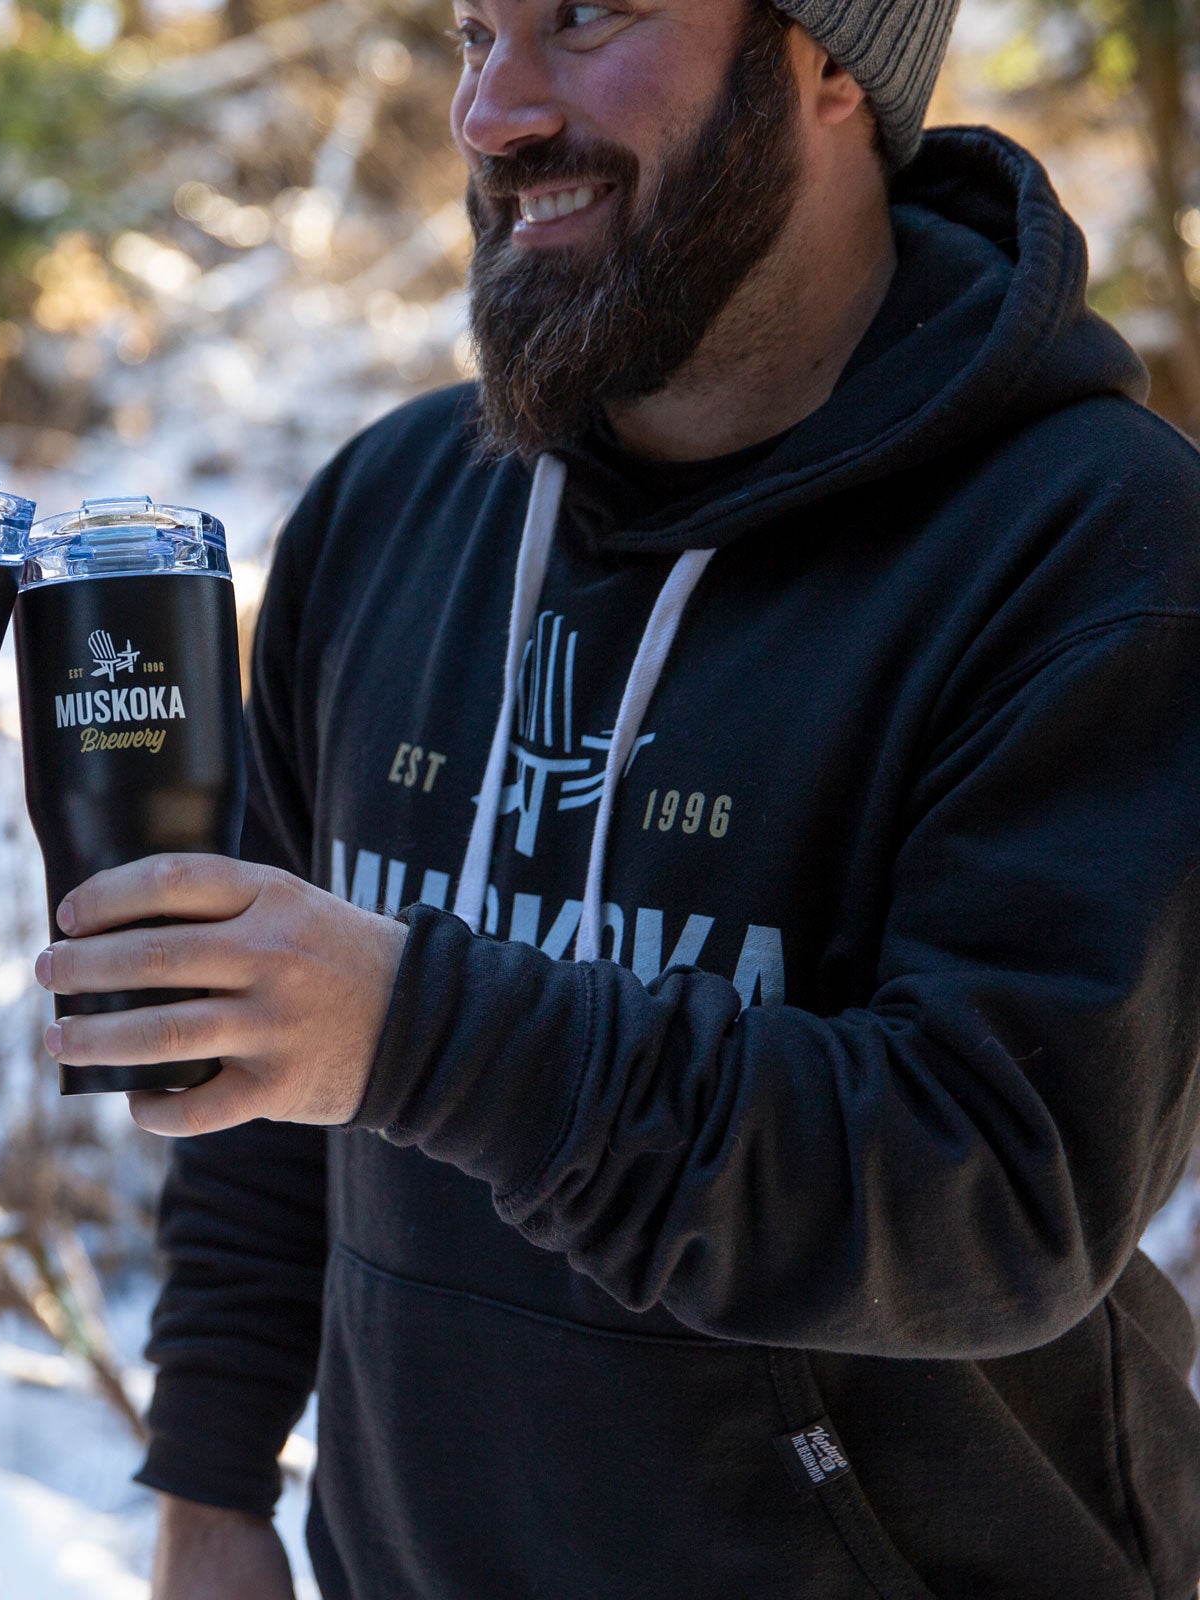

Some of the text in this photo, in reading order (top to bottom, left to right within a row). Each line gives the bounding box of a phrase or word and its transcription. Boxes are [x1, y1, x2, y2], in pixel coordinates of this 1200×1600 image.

[68, 662, 165, 680] EST 1996
[55, 685, 186, 728] MUSKOKA
[80, 728, 166, 754] Brewery
[388, 742, 732, 838] EST 1996
[807, 1426, 848, 1468] Venture
